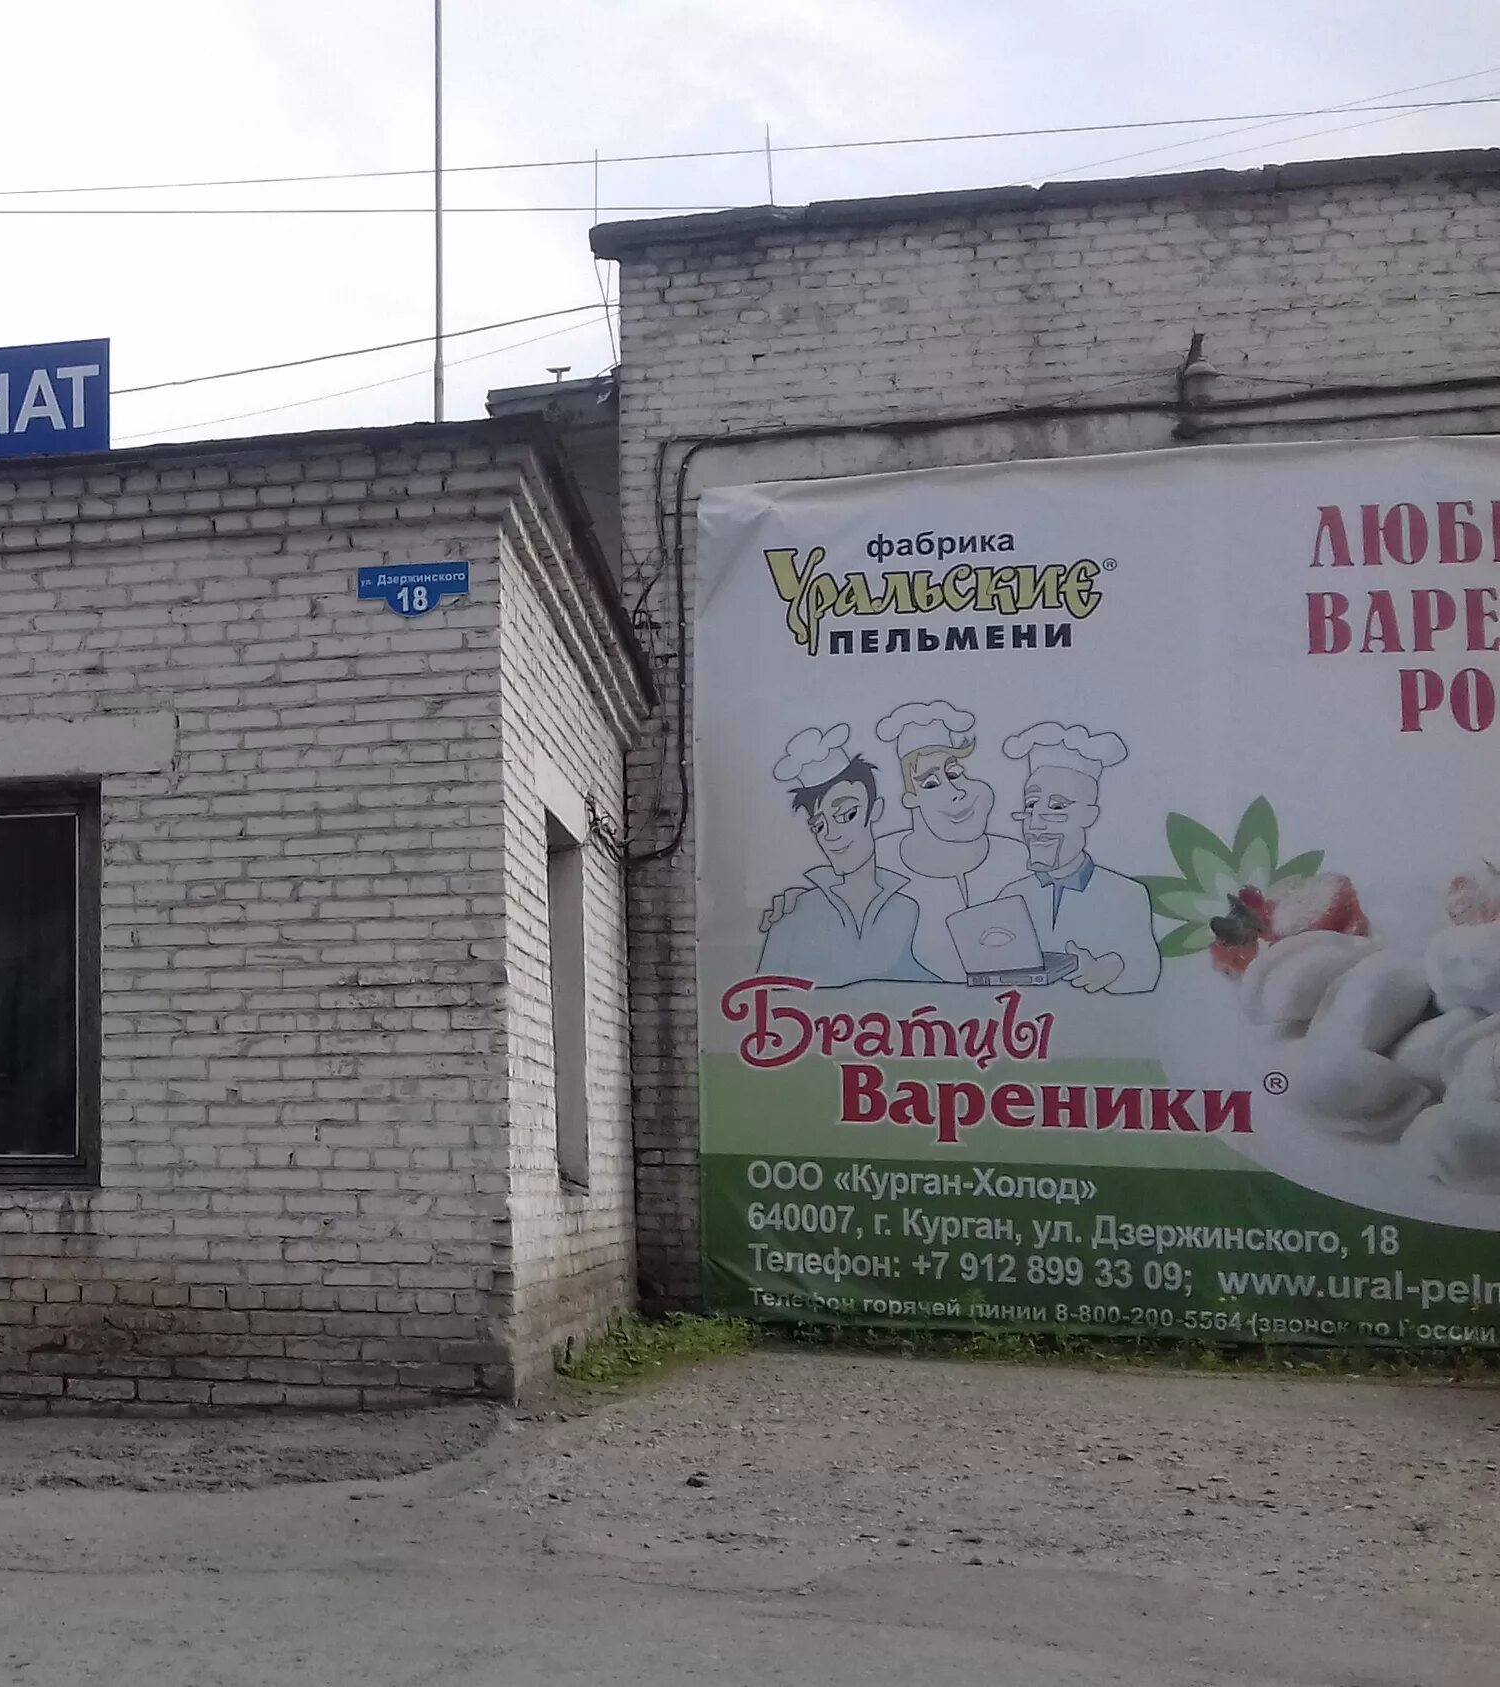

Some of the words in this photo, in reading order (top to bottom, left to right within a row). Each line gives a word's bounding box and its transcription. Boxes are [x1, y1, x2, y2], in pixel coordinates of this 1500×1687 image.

[866, 533, 1015, 562] фабрика
[377, 572, 466, 586] Дзержинского
[397, 586, 428, 612] 18
[763, 547, 1102, 656] Уральские
[829, 623, 1072, 654] ПЕЛЬМЕНИ
[721, 976, 1054, 1070] Братцы
[840, 1063, 1254, 1143] Вареники
[747, 1160, 823, 1192] ООО
[833, 1164, 1098, 1205] «Курган-Холод»
[748, 1202, 864, 1239] 640007,
[874, 1213, 892, 1236] г.
[903, 1208, 1023, 1247] Курган,
[1032, 1218, 1083, 1249] ул.
[1091, 1215, 1348, 1260] Дзержинского,
[1361, 1225, 1399, 1256] 18
[748, 1243, 901, 1283] Телефон:
[912, 1251, 950, 1279] +7
[960, 1252, 1017, 1283] 912
[1027, 1255, 1084, 1287] 899
[1094, 1258, 1134, 1290] 33
[1144, 1261, 1193, 1297] 09;
[864, 1298, 960, 1318] горячей
[969, 1304, 1047, 1322] линии
[1056, 1304, 1242, 1332] 8-800-200-5564
